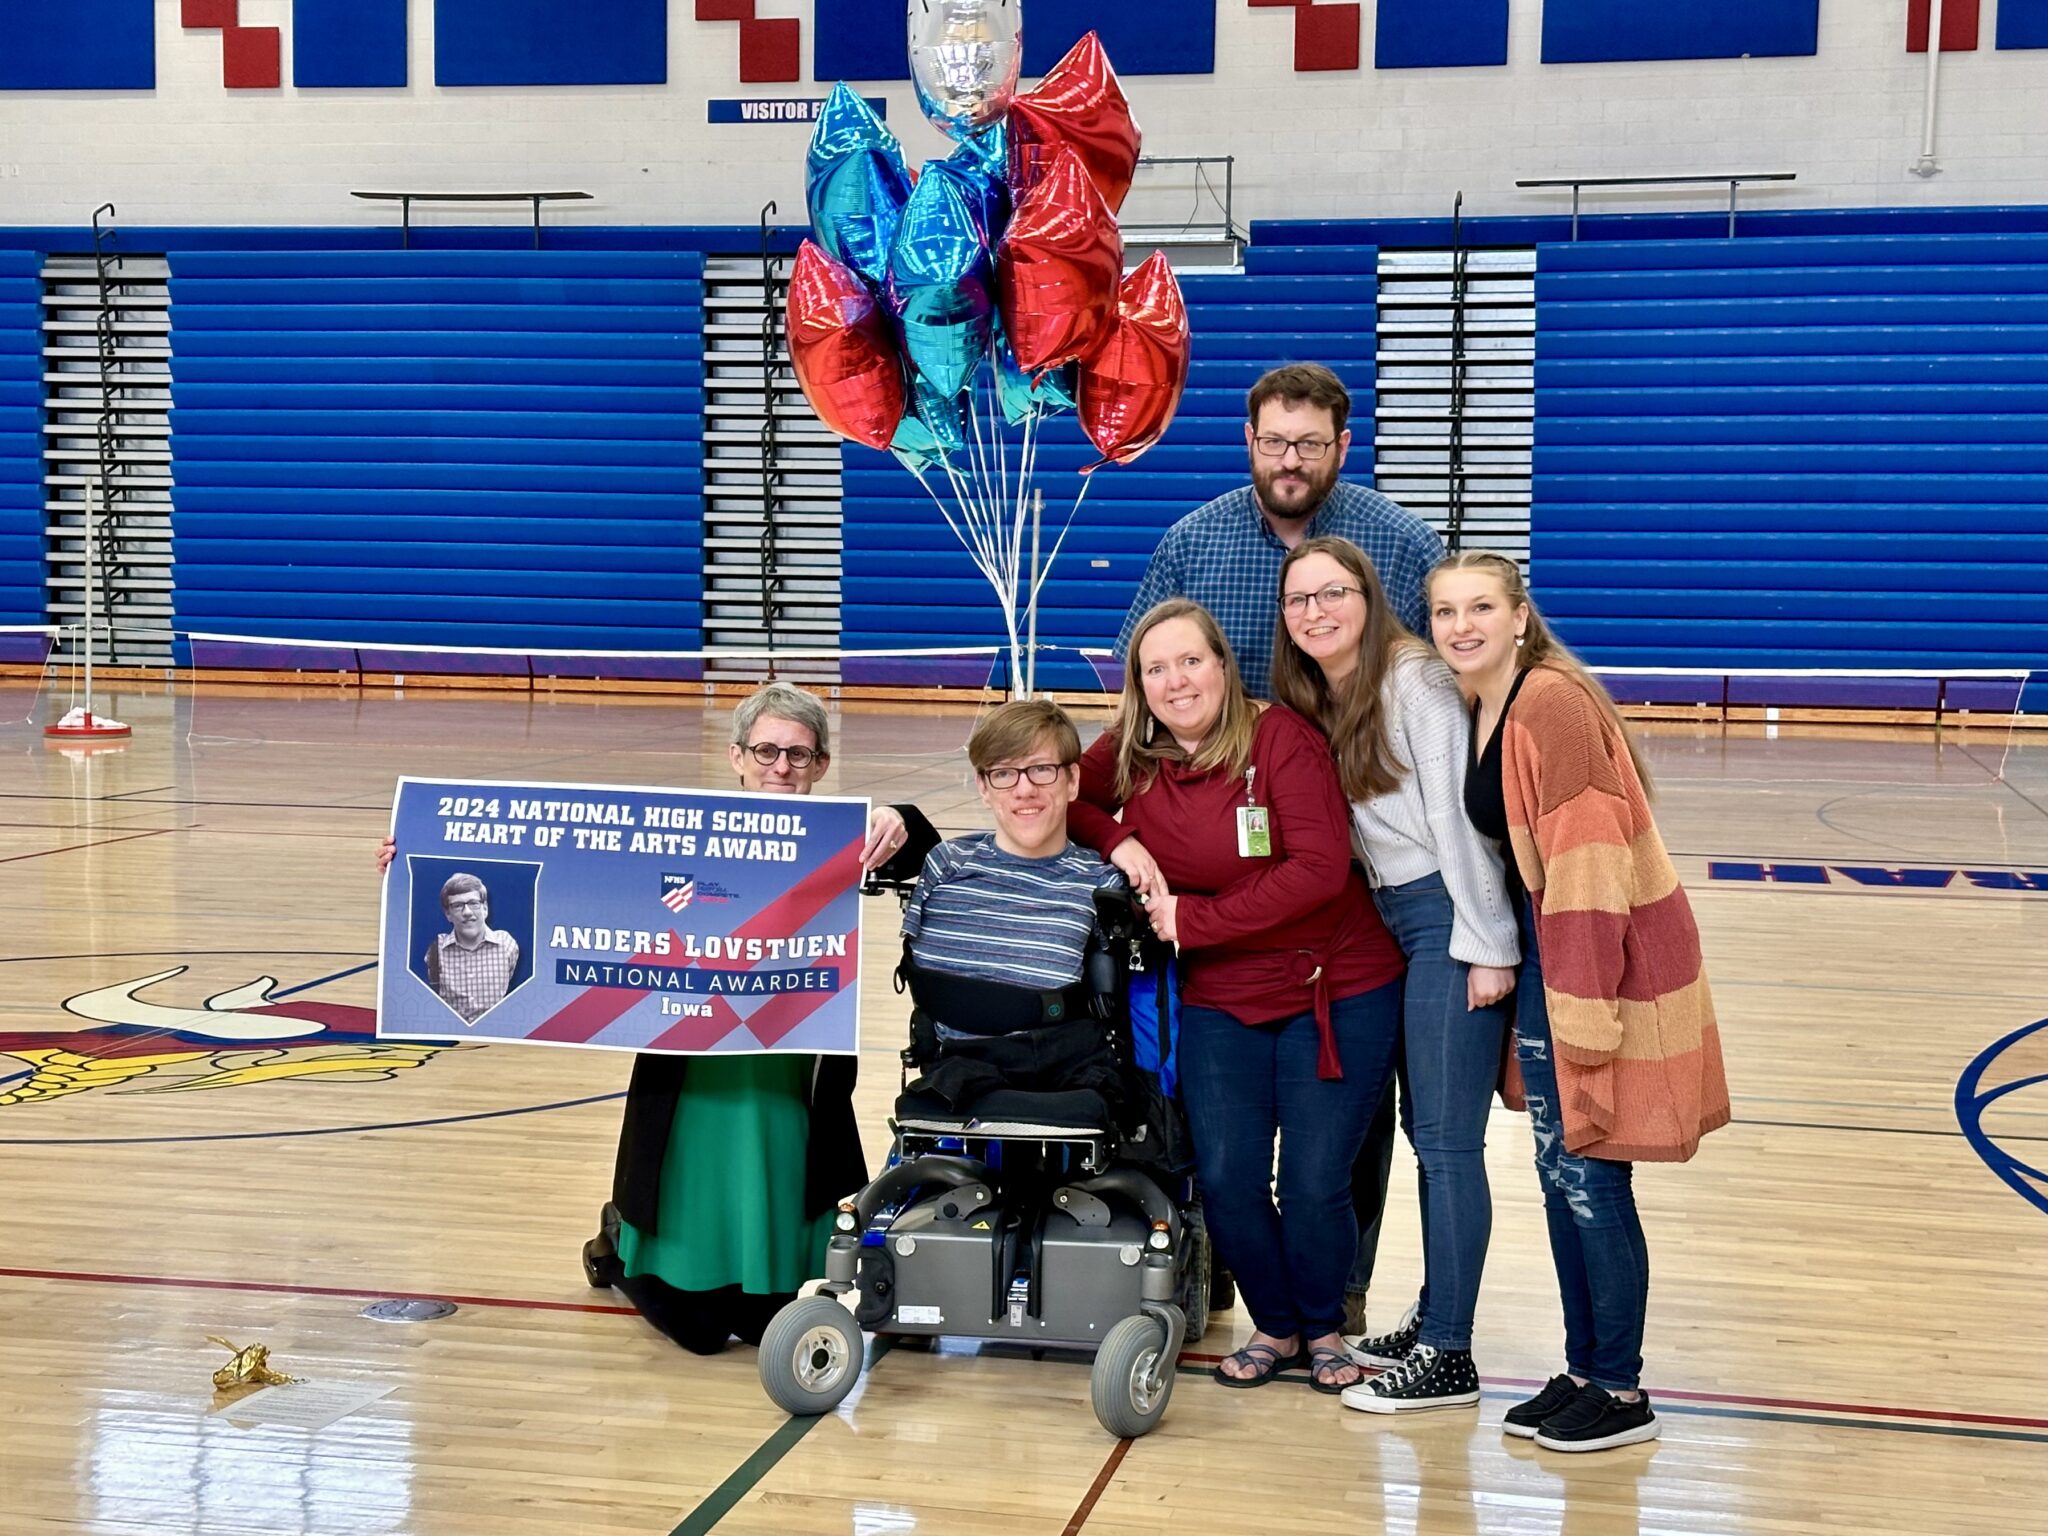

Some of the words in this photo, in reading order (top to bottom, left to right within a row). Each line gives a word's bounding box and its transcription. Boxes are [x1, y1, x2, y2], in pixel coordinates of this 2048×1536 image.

[741, 102, 808, 120] VISITOR
[438, 797, 500, 818] 2024
[508, 799, 635, 826] NATIONAL
[643, 806, 704, 830] HIGH
[712, 811, 807, 836] SCHOOL
[444, 821, 527, 845] HEART
[534, 826, 565, 848] OF
[573, 828, 622, 852] THE
[629, 832, 696, 856] ARTS
[704, 836, 797, 862] AWARD
[550, 925, 671, 956] ANDERS
[684, 933, 847, 961] LOVSTUEN
[566, 964, 694, 990] NATIONAL
[709, 971, 829, 992] AWARDEE
[661, 996, 713, 1018] Iowa
